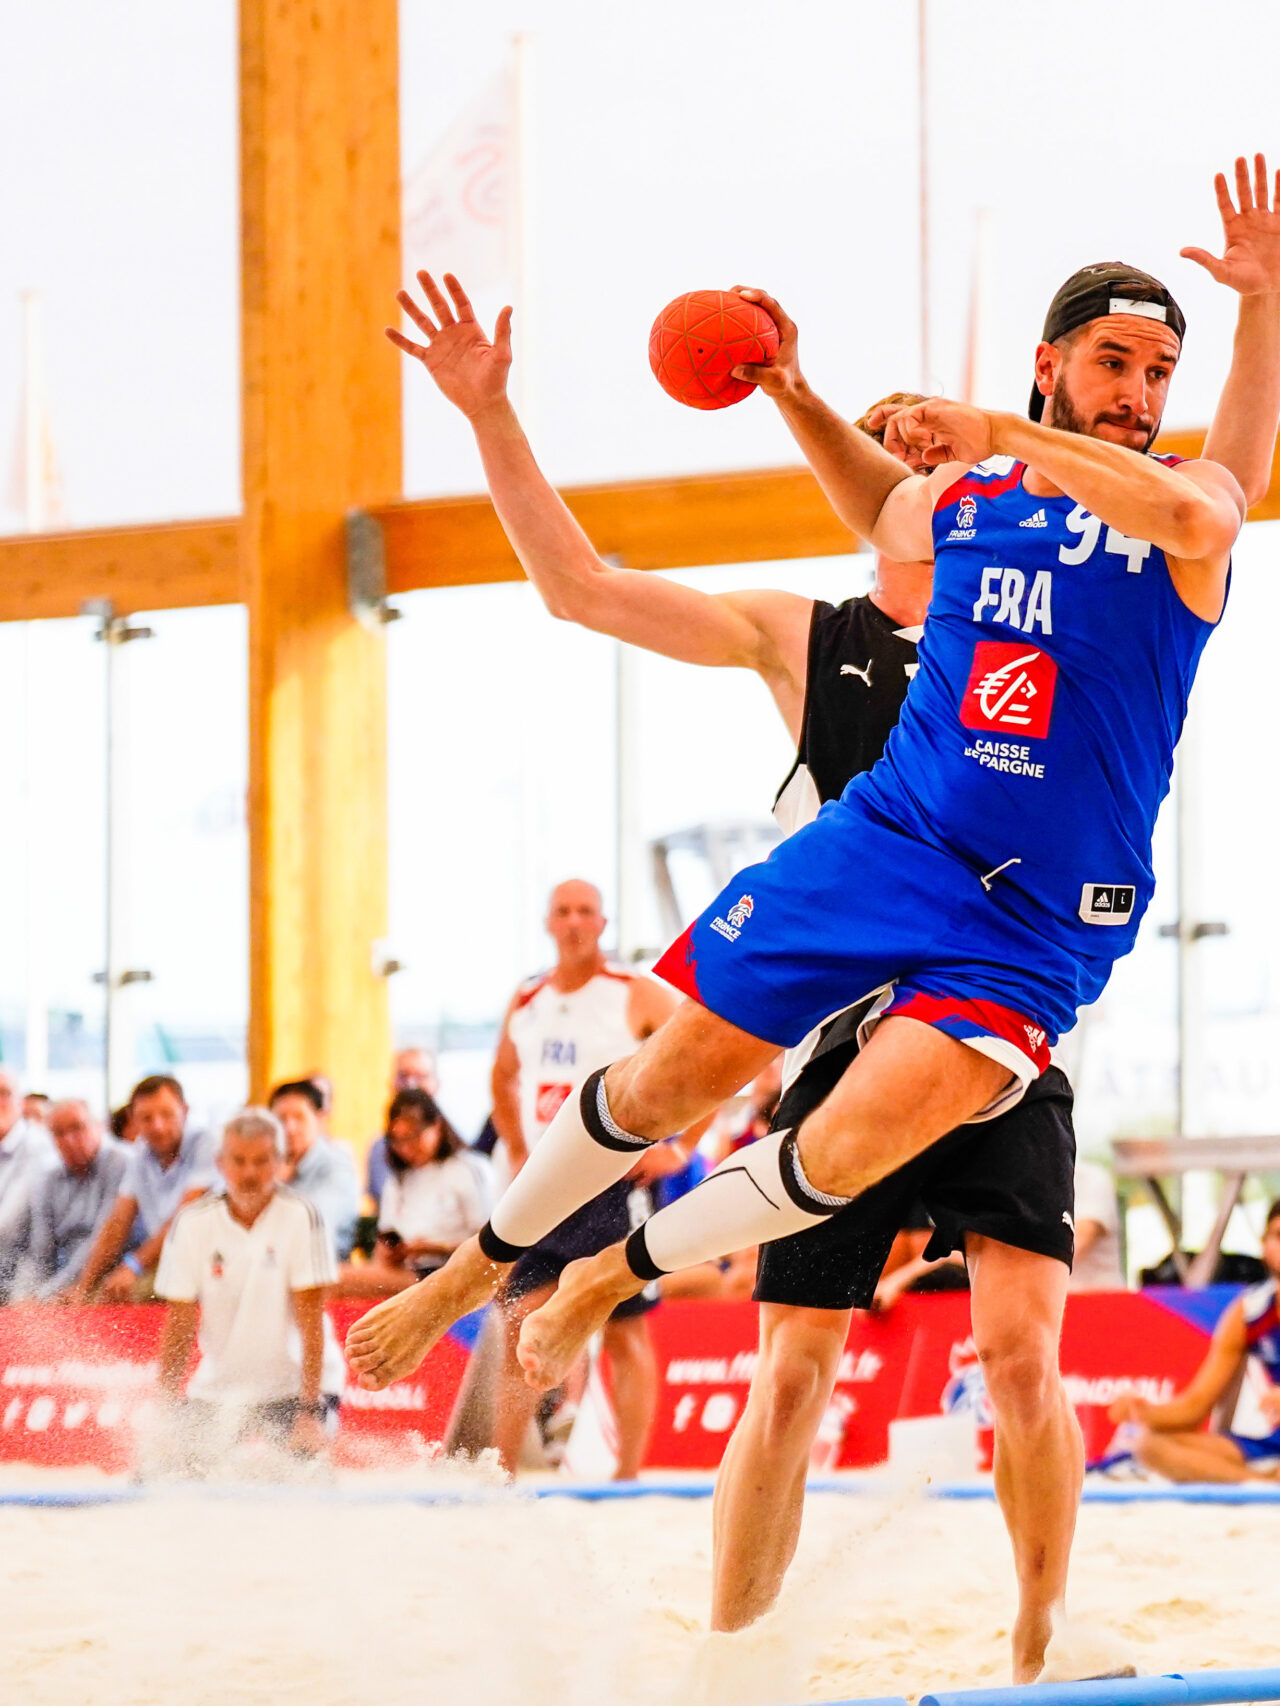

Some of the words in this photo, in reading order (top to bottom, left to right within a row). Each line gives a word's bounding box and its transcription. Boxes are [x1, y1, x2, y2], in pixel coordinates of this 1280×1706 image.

[1058, 502, 1152, 574] 94
[972, 566, 1053, 635] FRA
[975, 739, 1031, 761] CAISSE
[540, 1039, 577, 1067] FRA
